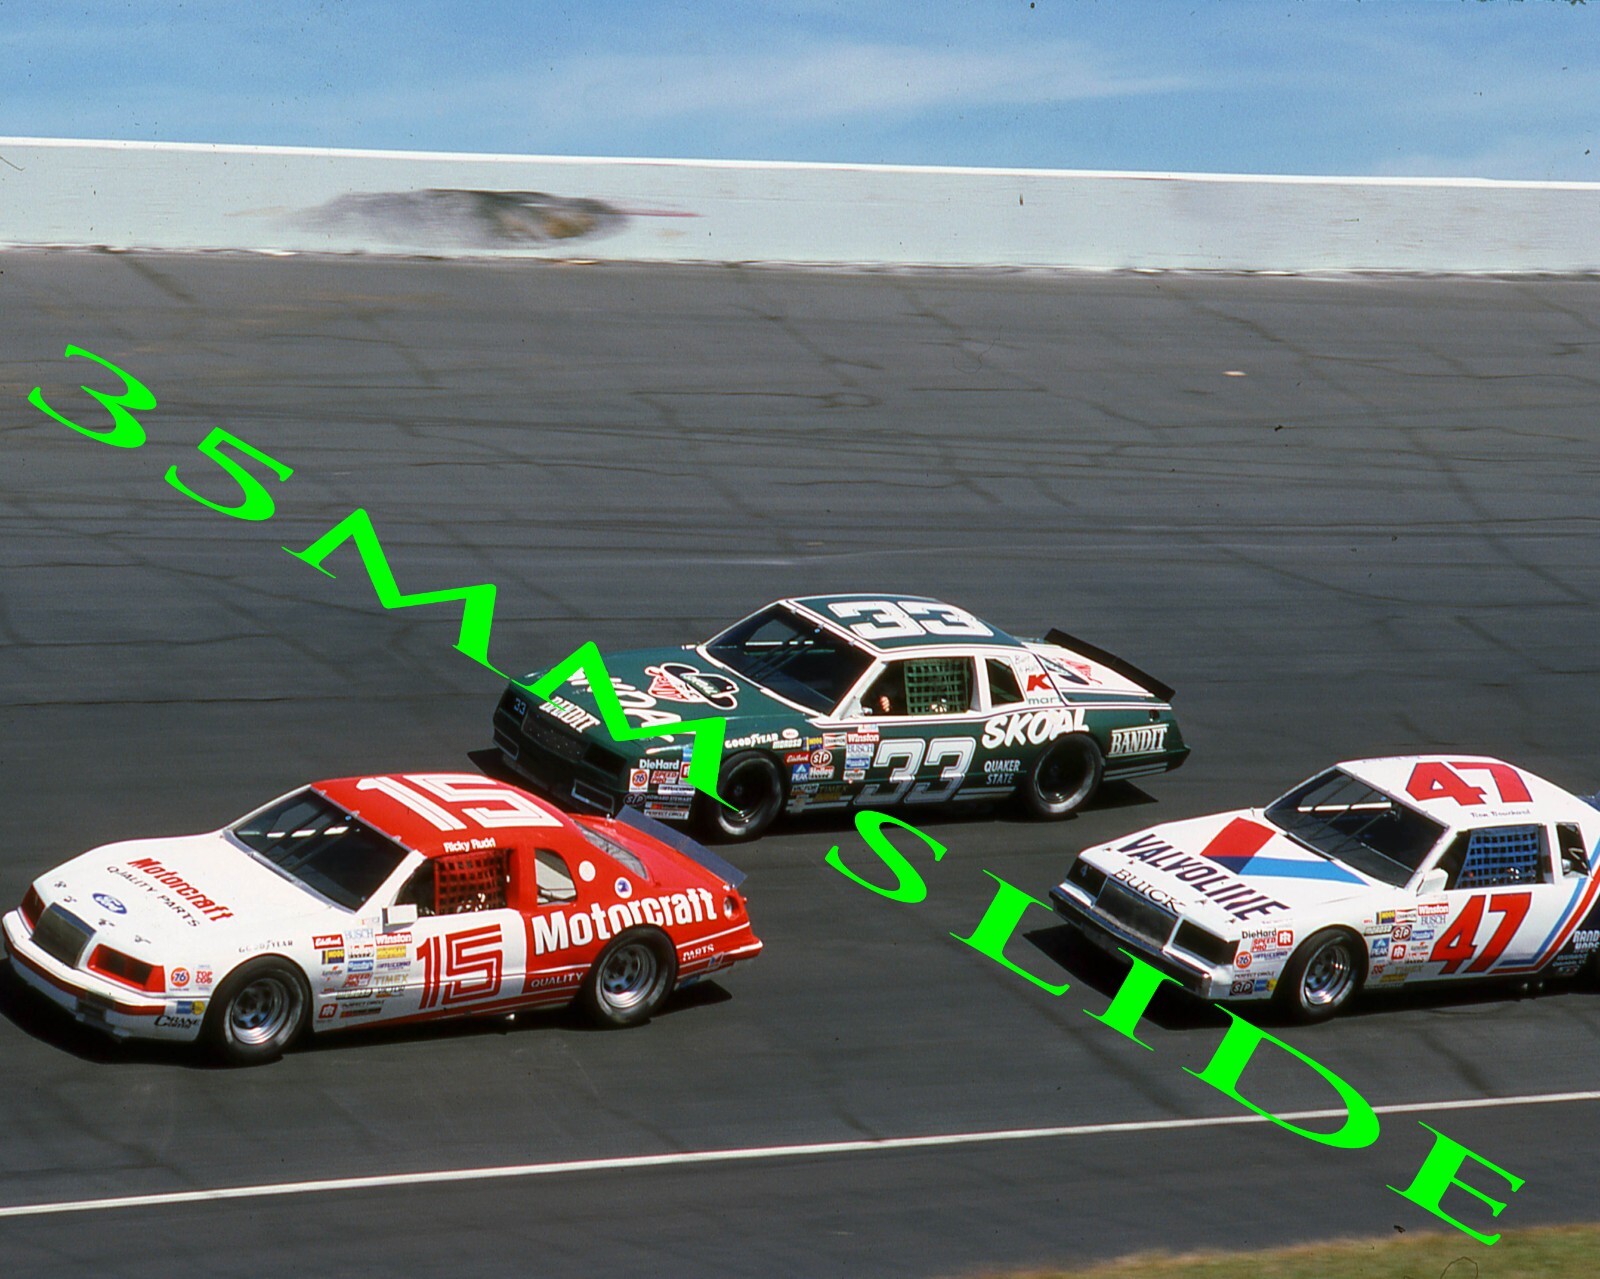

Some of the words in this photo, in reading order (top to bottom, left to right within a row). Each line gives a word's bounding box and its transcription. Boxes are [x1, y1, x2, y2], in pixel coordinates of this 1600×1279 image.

[828, 600, 994, 639] 33
[1026, 673, 1053, 692] K
[513, 698, 527, 716] 33
[847, 734, 880, 743] Winston
[981, 708, 1090, 750] SKOAL
[724, 733, 779, 749] GOODYEAR
[1112, 728, 1168, 754] BANDIT
[639, 759, 680, 770] DieHard
[873, 737, 977, 805] 33
[983, 760, 1021, 774] QUAKER
[985, 773, 1014, 786] STATE
[1405, 761, 1534, 806] 47
[356, 774, 563, 832] 15
[443, 841, 470, 853] Ricky
[470, 836, 497, 849] Rudd
[1117, 833, 1290, 921] VALVOLINE
[106, 865, 158, 894] QUALITY
[156, 894, 201, 928] PARTS
[126, 857, 234, 922] Motorcraft
[1114, 868, 1187, 915] BUICK
[1418, 905, 1449, 914] Winston
[531, 887, 718, 955] Motorcraft
[376, 934, 411, 945] Winston
[1241, 928, 1277, 939] DieHard
[1428, 892, 1532, 975] 47
[682, 944, 715, 961] PARTS
[416, 924, 504, 1010] 15
[374, 974, 409, 985] TIMEX
[531, 972, 584, 988] QUALITY
